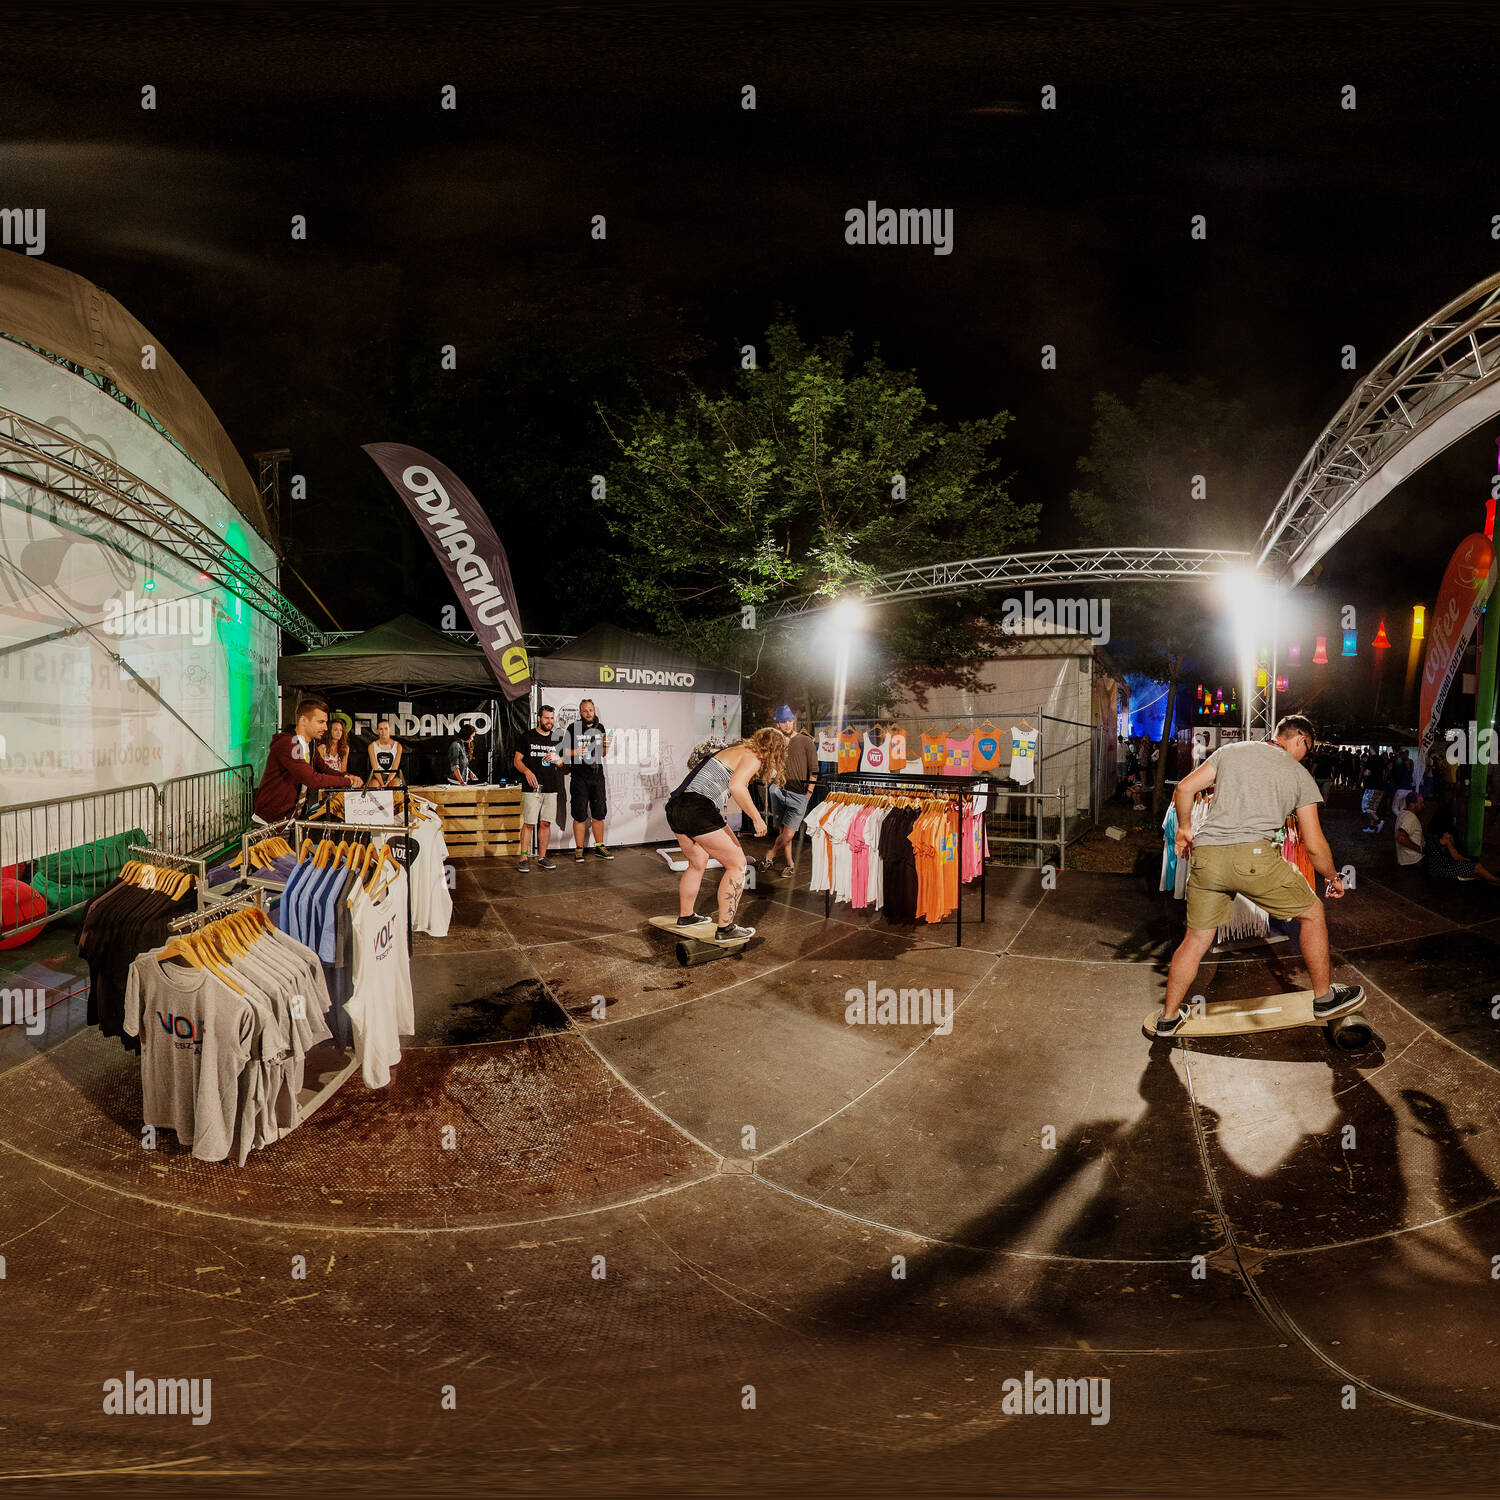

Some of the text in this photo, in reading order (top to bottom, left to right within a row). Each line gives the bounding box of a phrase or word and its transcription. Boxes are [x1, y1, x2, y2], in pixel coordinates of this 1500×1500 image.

[402, 465, 523, 651] FUNDANGO
[1425, 597, 1460, 686] coffee
[1449, 634, 1468, 674] COFFEE
[616, 667, 695, 688] FUNDANGO
[378, 757, 391, 765] VOLT
[868, 753, 882, 762] VOLT
[391, 847, 411, 860] VOL
[373, 913, 397, 953] VOLT
